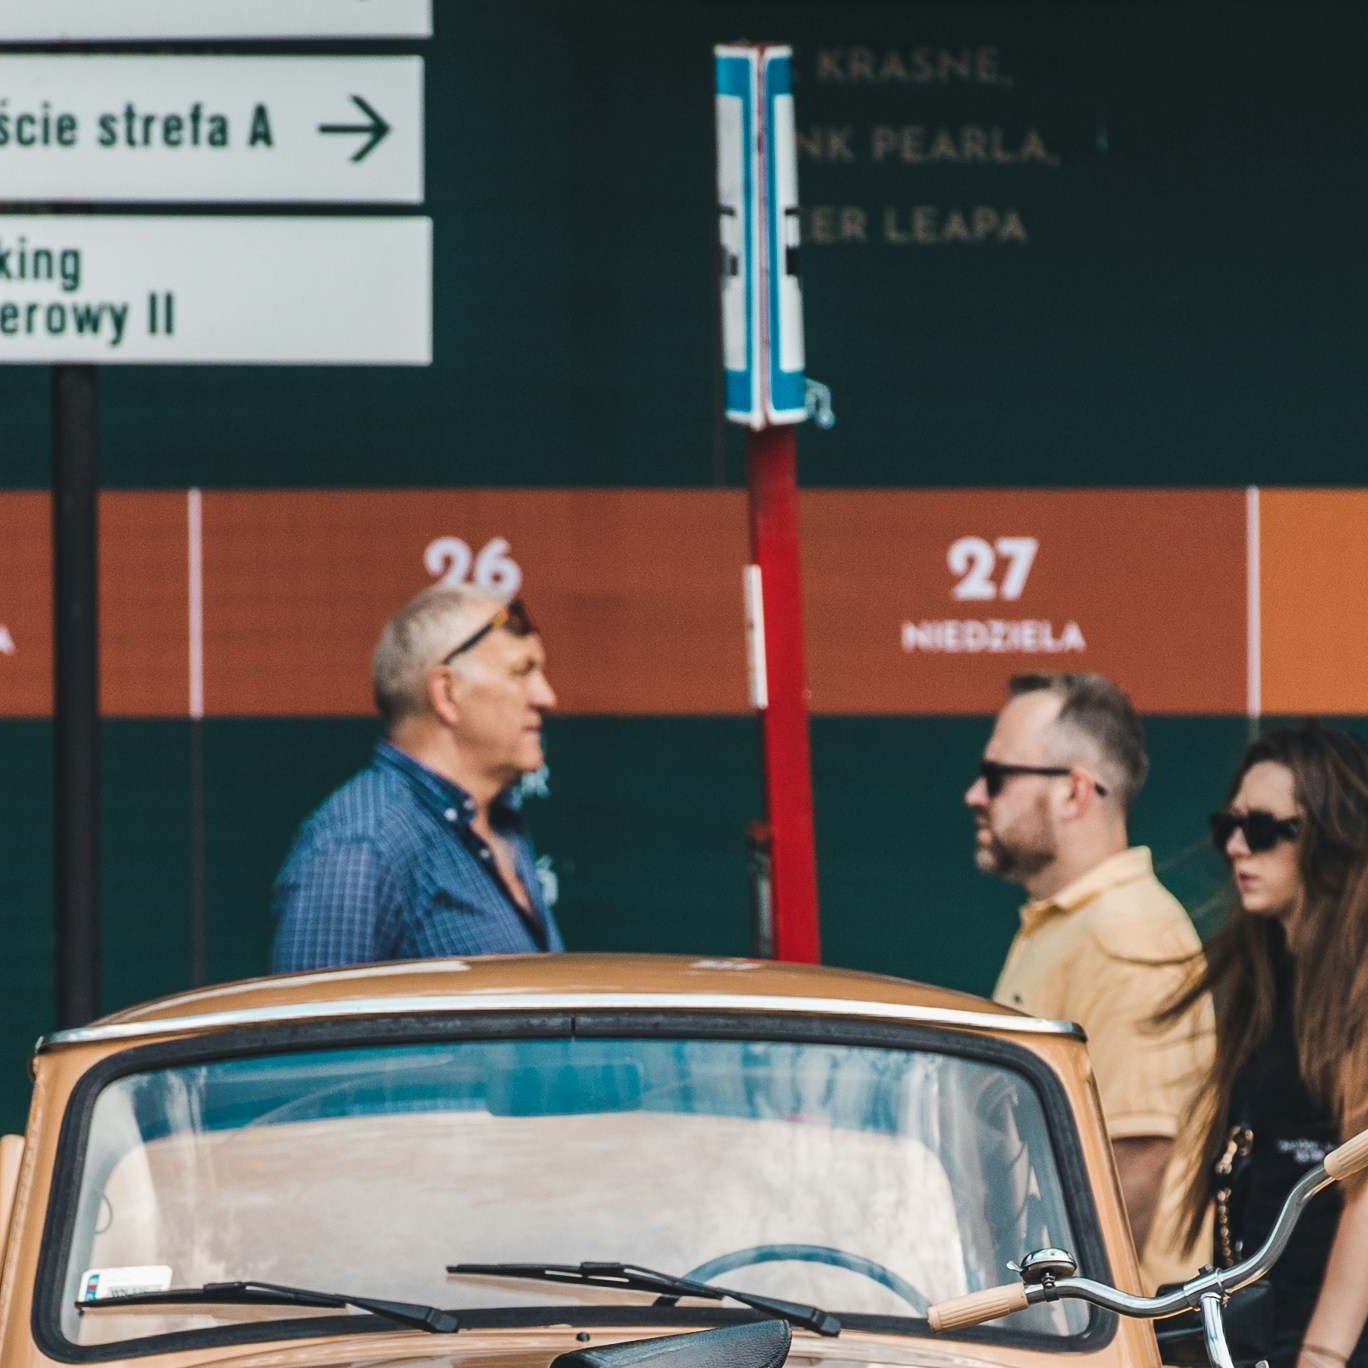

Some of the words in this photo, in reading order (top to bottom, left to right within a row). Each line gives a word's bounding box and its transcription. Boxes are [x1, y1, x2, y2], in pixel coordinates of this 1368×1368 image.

[98, 101, 229, 149] strefa
[248, 102, 274, 148] A
[884, 206, 1029, 244] LEAPA
[148, 291, 175, 337] II
[423, 535, 524, 592] 26
[946, 535, 1039, 602] 27
[900, 618, 1087, 654] NIEDZIELA
